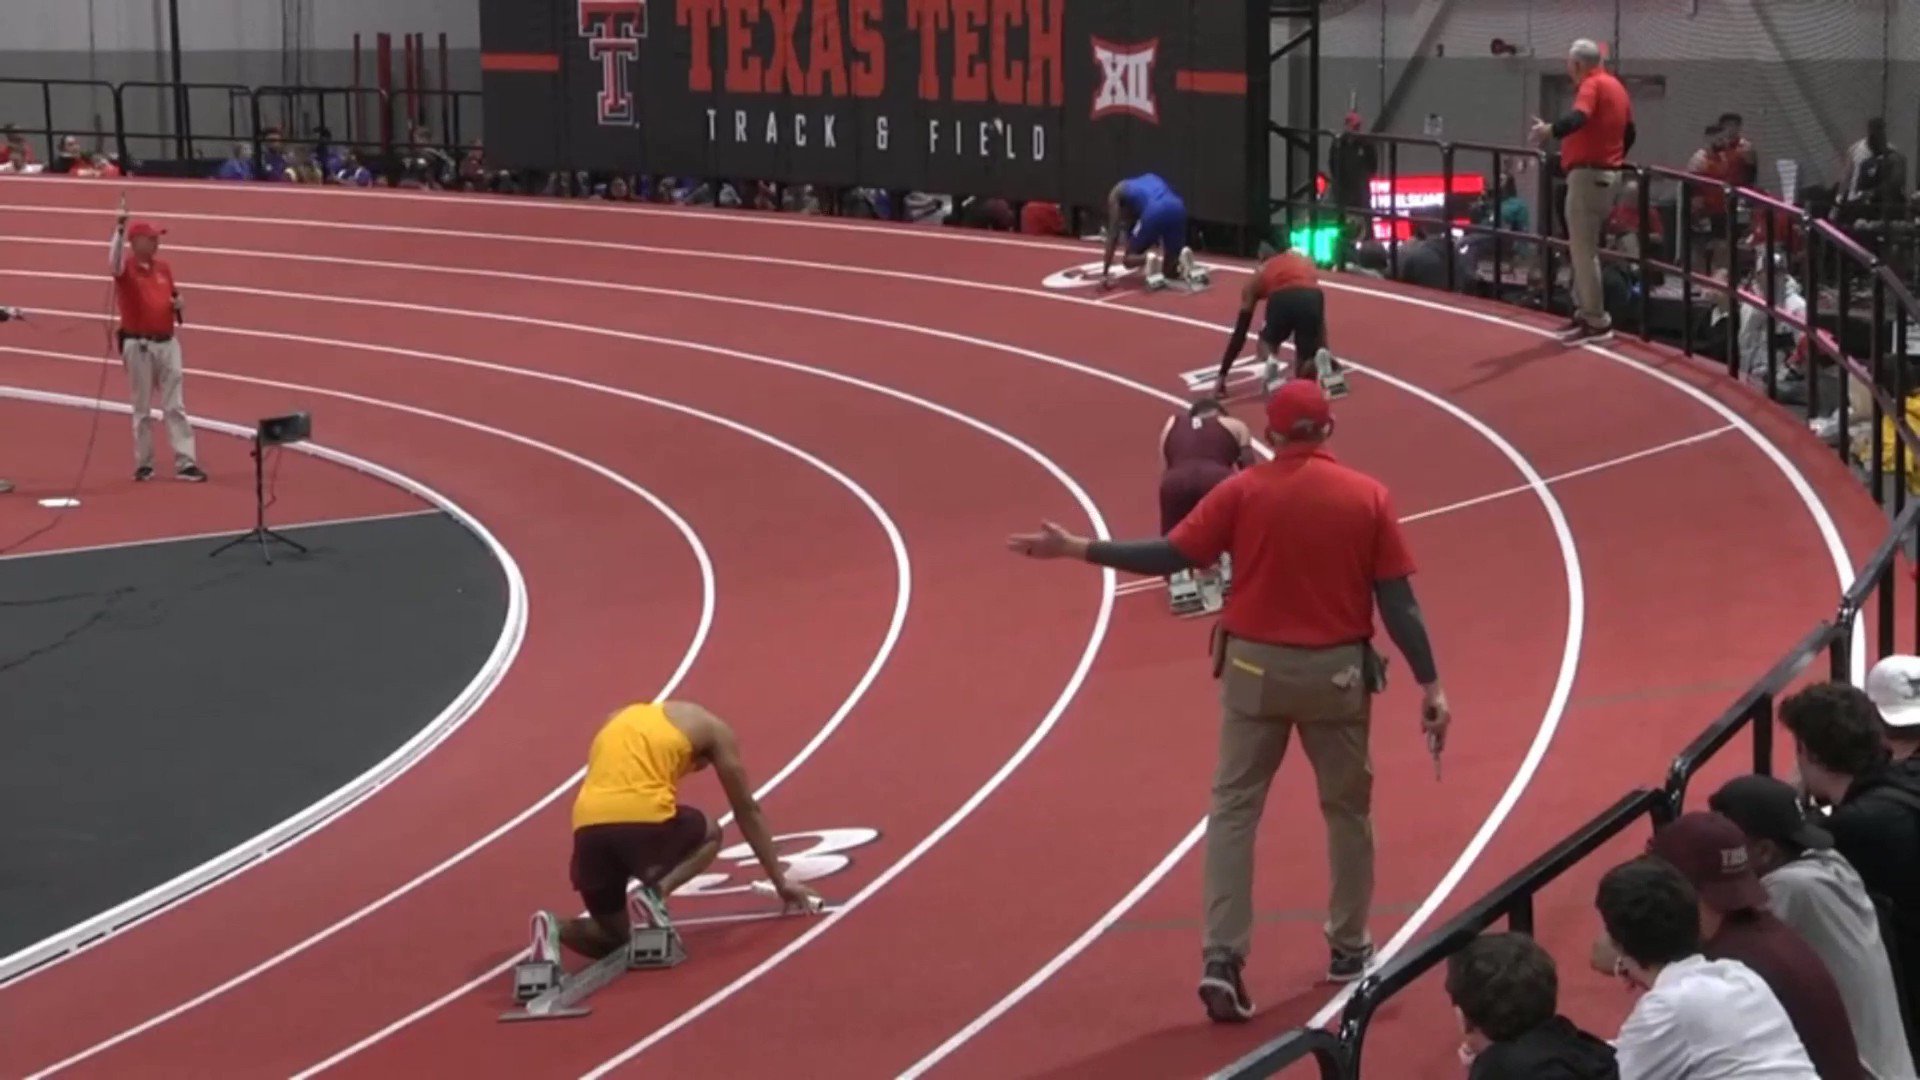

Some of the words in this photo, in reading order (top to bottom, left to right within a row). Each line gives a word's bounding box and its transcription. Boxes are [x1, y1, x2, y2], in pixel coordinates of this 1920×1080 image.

[676, 0, 885, 97] TEXAS
[907, 0, 1064, 106] TECH
[707, 109, 836, 148] TRACK
[876, 116, 888, 150] &
[929, 119, 1045, 161] FIELD
